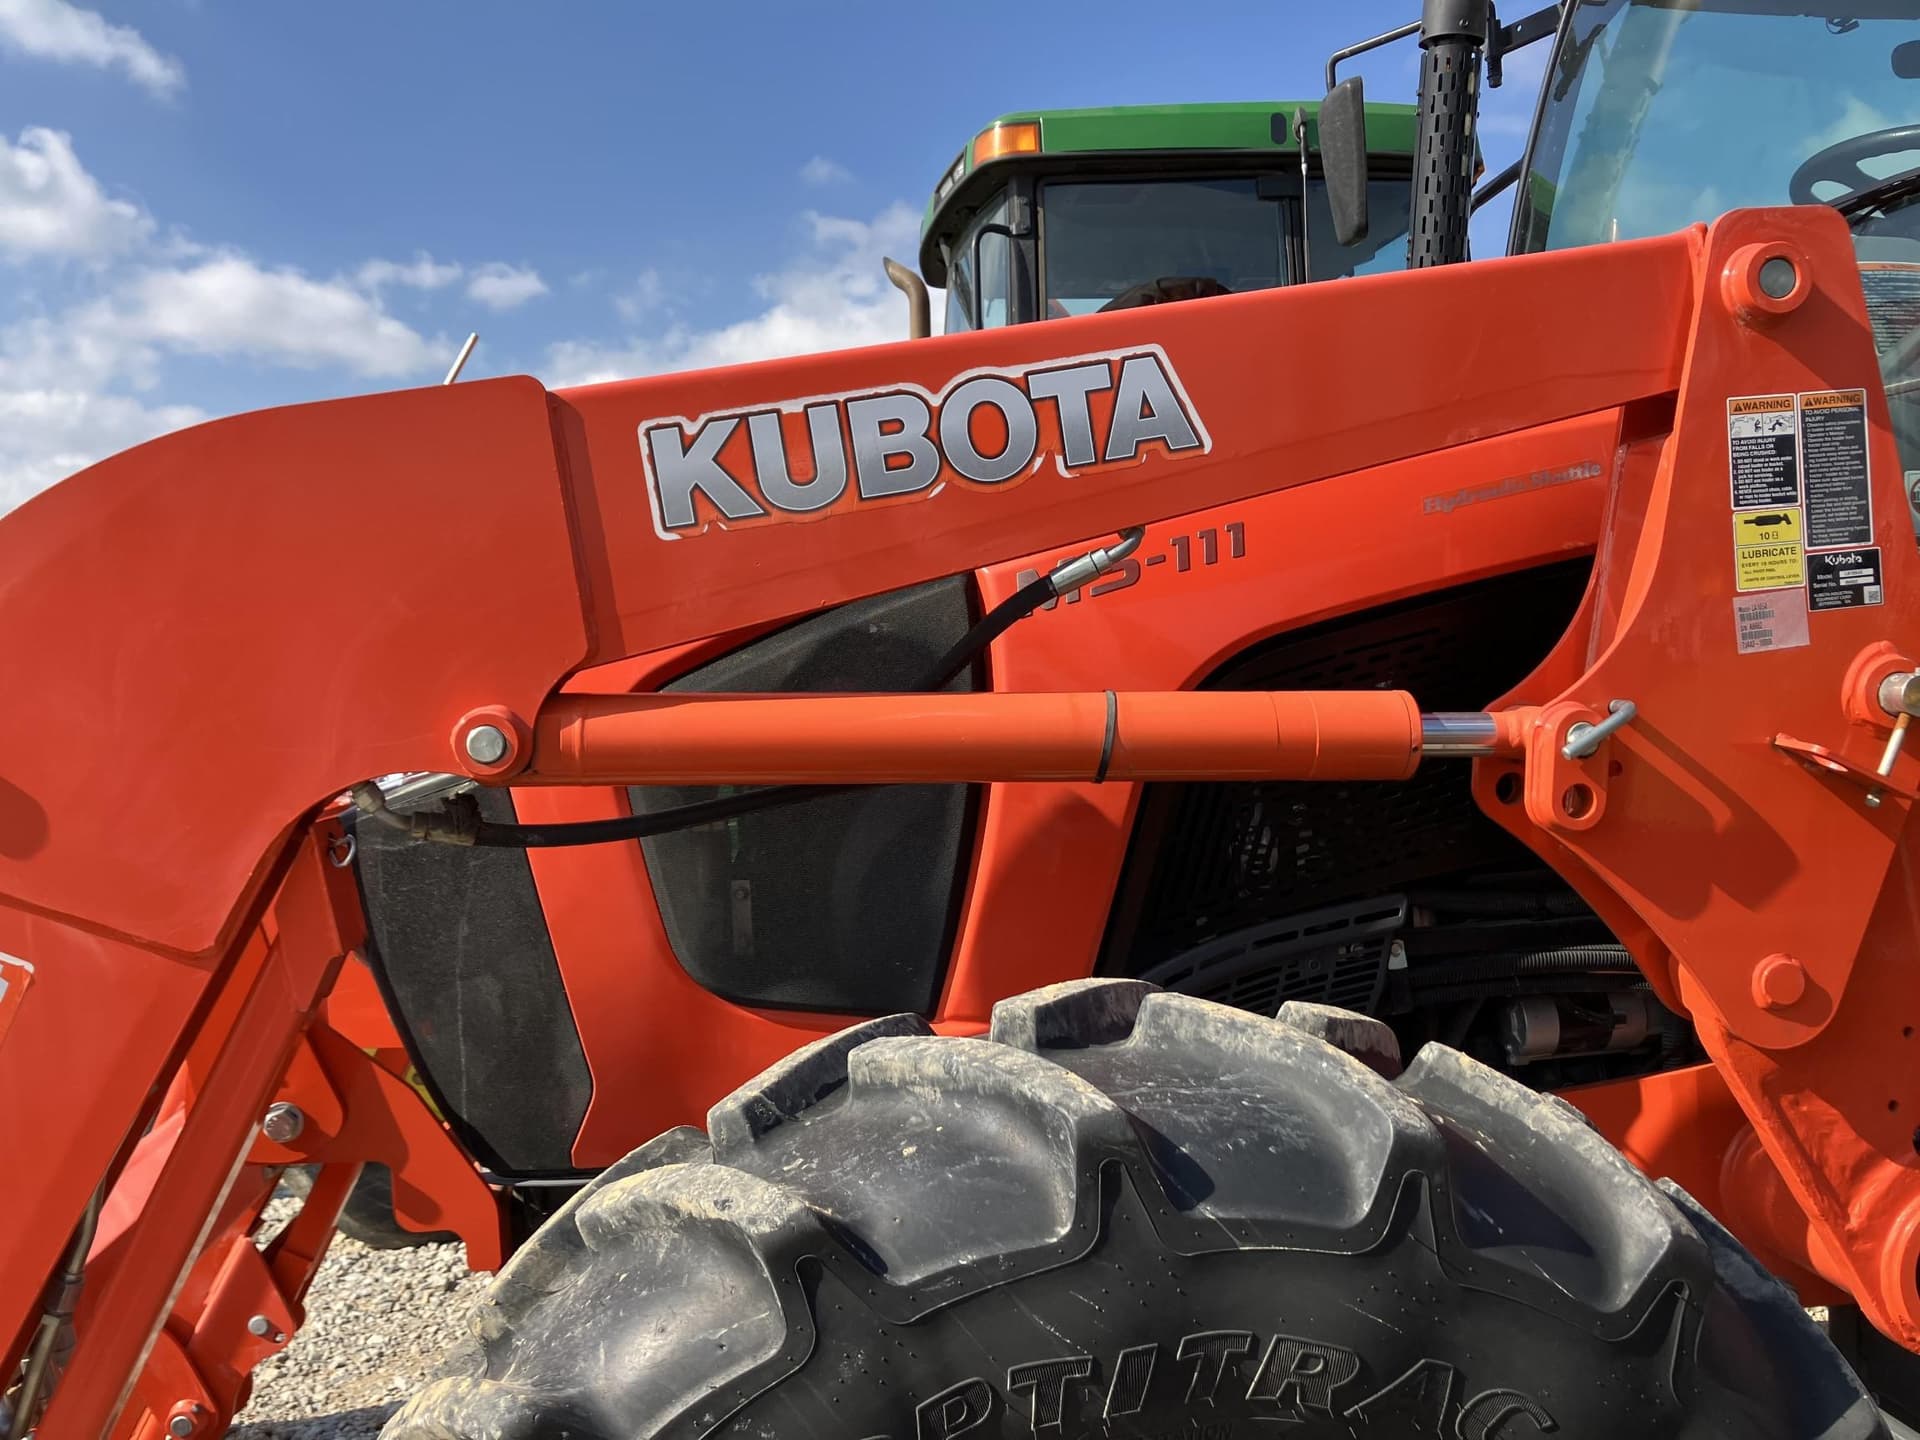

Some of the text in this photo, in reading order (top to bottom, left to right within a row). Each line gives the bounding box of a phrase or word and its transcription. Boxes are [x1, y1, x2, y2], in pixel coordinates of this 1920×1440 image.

[1742, 399, 1791, 411] WARNING
[1813, 393, 1861, 405] WARNING
[647, 353, 1202, 529] KUBOTA
[1759, 532, 1770, 541] 10
[1742, 546, 1797, 559] LUBRICATE
[1825, 553, 1863, 566] Kubota
[859, 1330, 1560, 1440] PTITRAC
